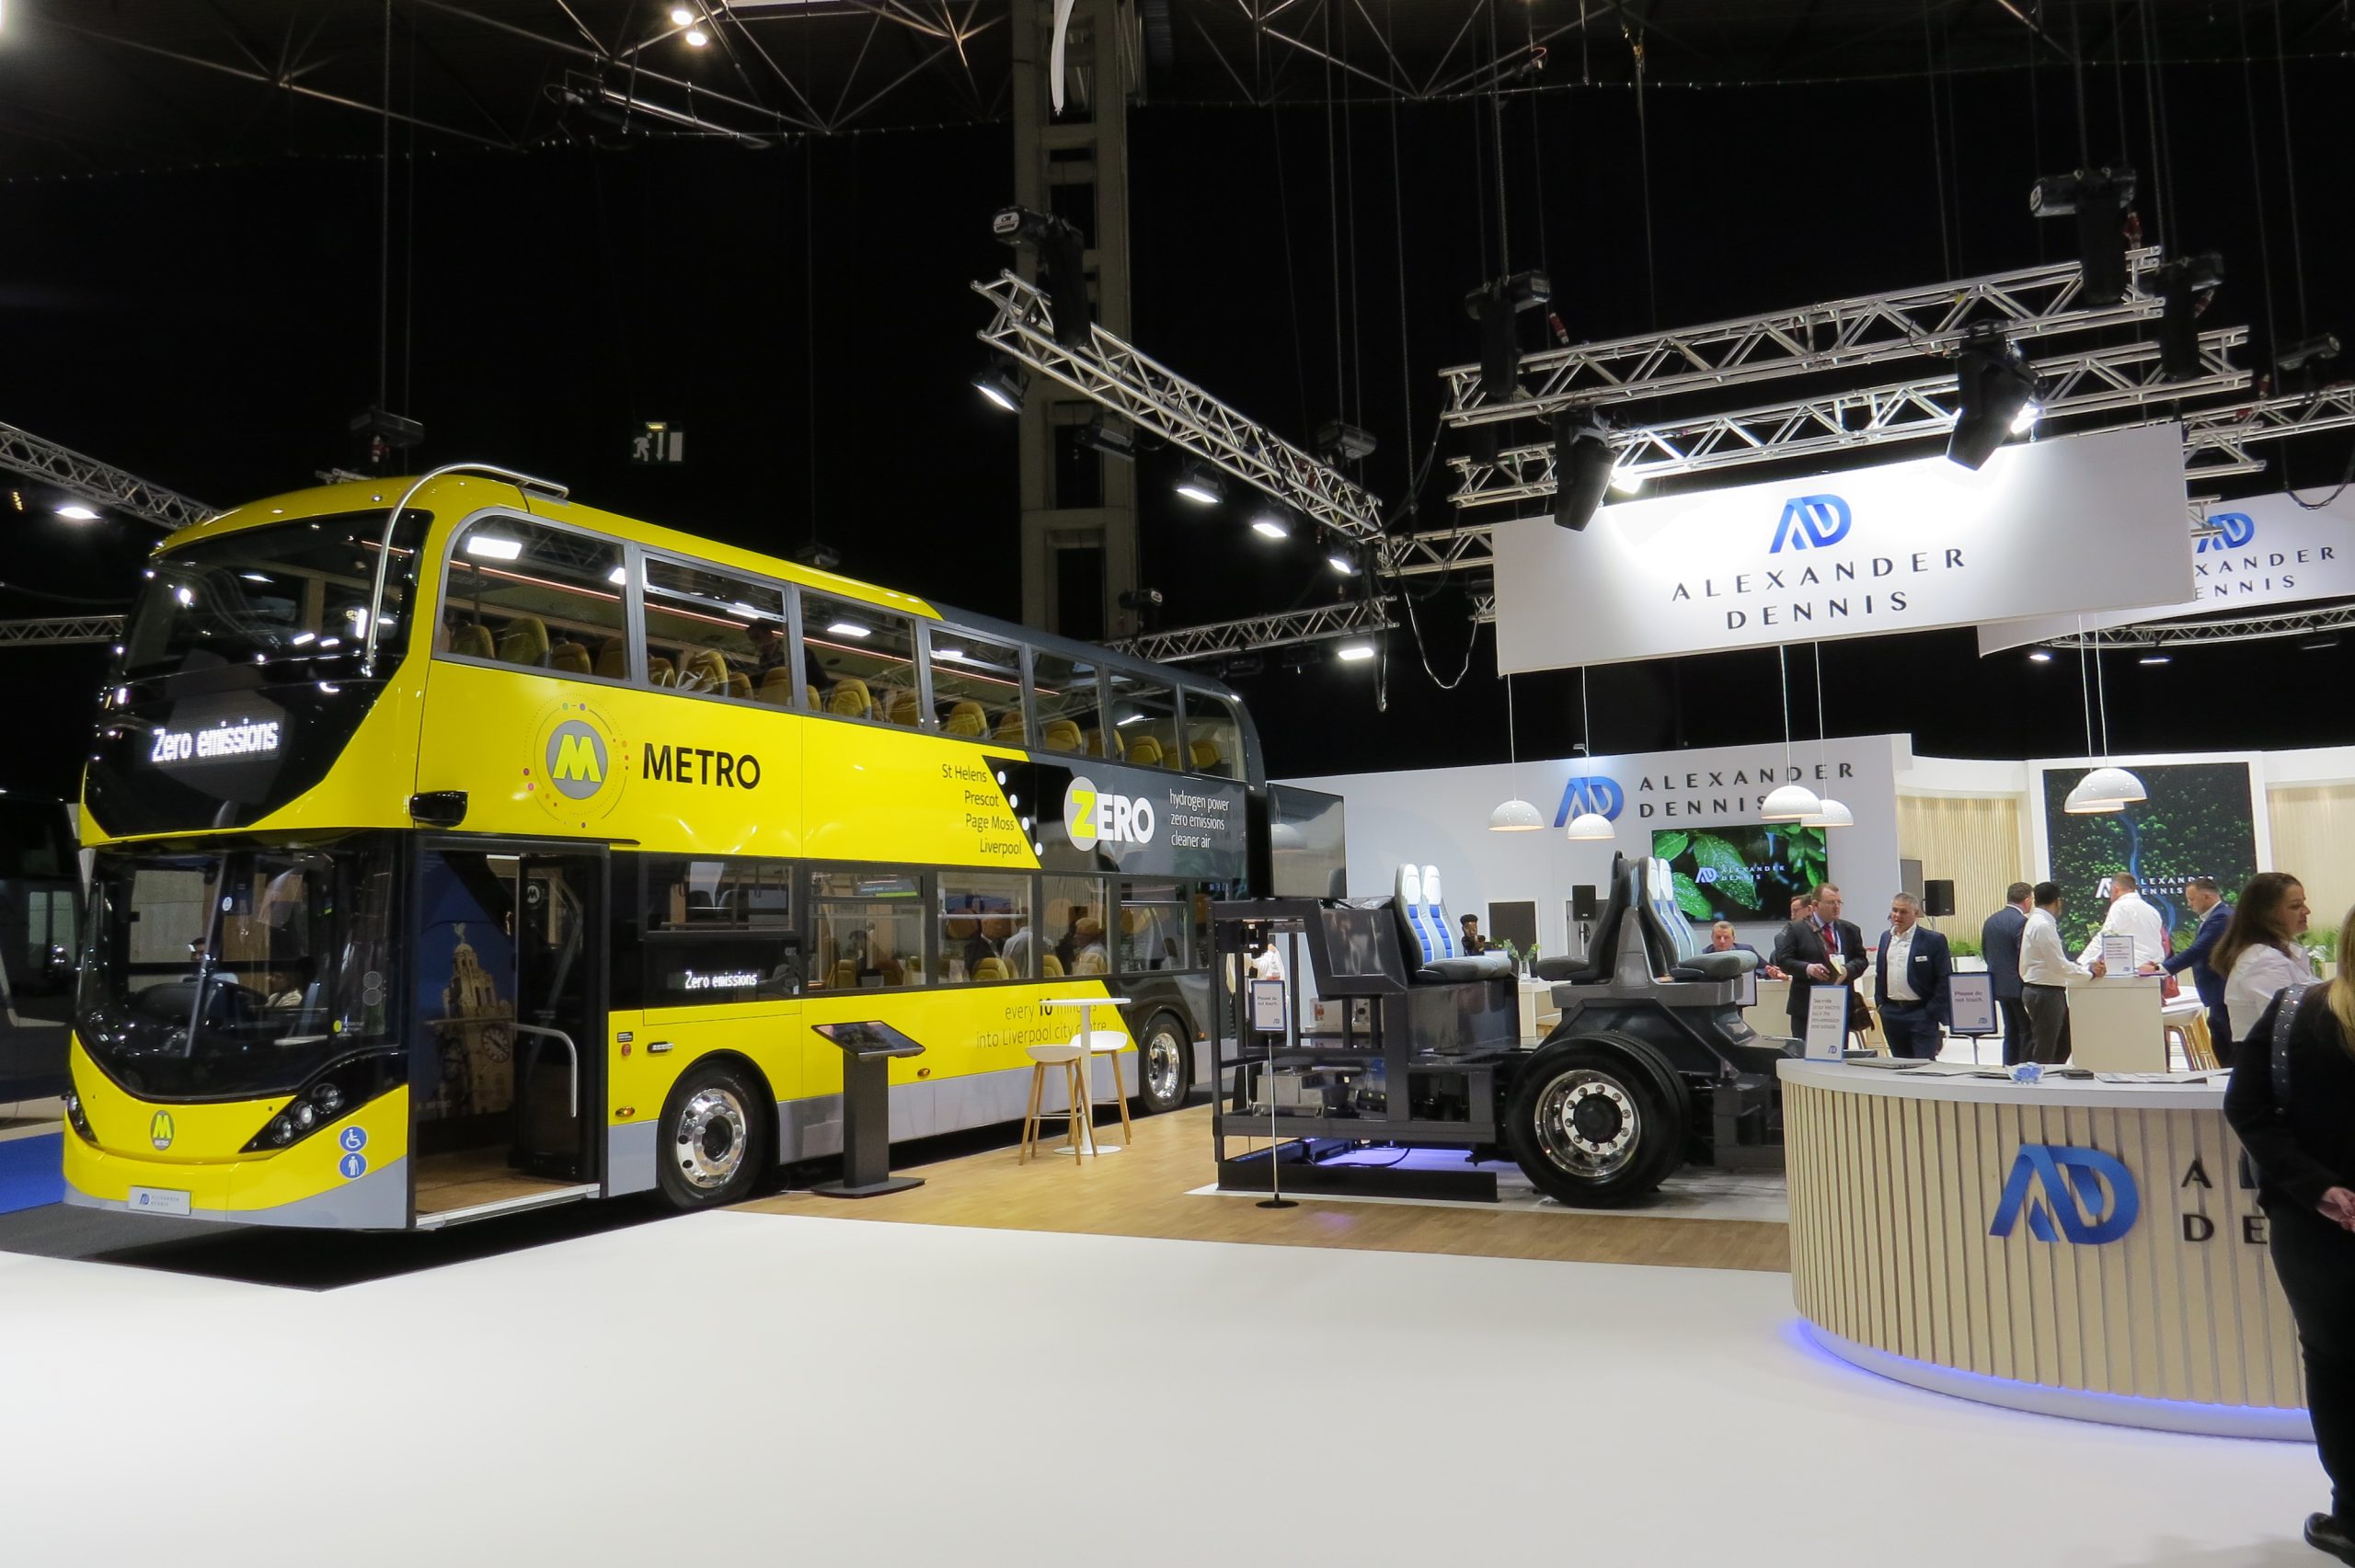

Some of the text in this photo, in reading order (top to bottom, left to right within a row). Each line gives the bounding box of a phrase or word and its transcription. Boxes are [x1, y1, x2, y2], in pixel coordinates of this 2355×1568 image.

[1671, 548, 1966, 602] ALEXANDER
[2195, 546, 2336, 578] XANDER
[2195, 575, 2295, 601] ENNIS
[1726, 590, 1908, 630] DENNIS
[152, 717, 280, 762] Zero emissions
[642, 742, 761, 790] METRO
[941, 763, 988, 784] St Helens
[1639, 762, 1855, 792] ALEXANDER
[964, 789, 1000, 807] Prescot
[1169, 787, 1230, 813] hydrogen power
[965, 812, 1015, 834] Page Moss
[1071, 788, 1155, 845] ZERO
[1170, 813, 1225, 830] zero emissions
[980, 838, 1022, 859] Liverpool
[1170, 830, 1212, 850] cleaner air
[2134, 887, 2184, 896] ENNIS
[684, 969, 759, 990] Zero emissions
[1005, 1003, 1035, 1023] every
[1039, 998, 1053, 1017] 10
[976, 1031, 1000, 1049] into
[1002, 1022, 1052, 1047] Liverpool
[1054, 1022, 1074, 1040] city
